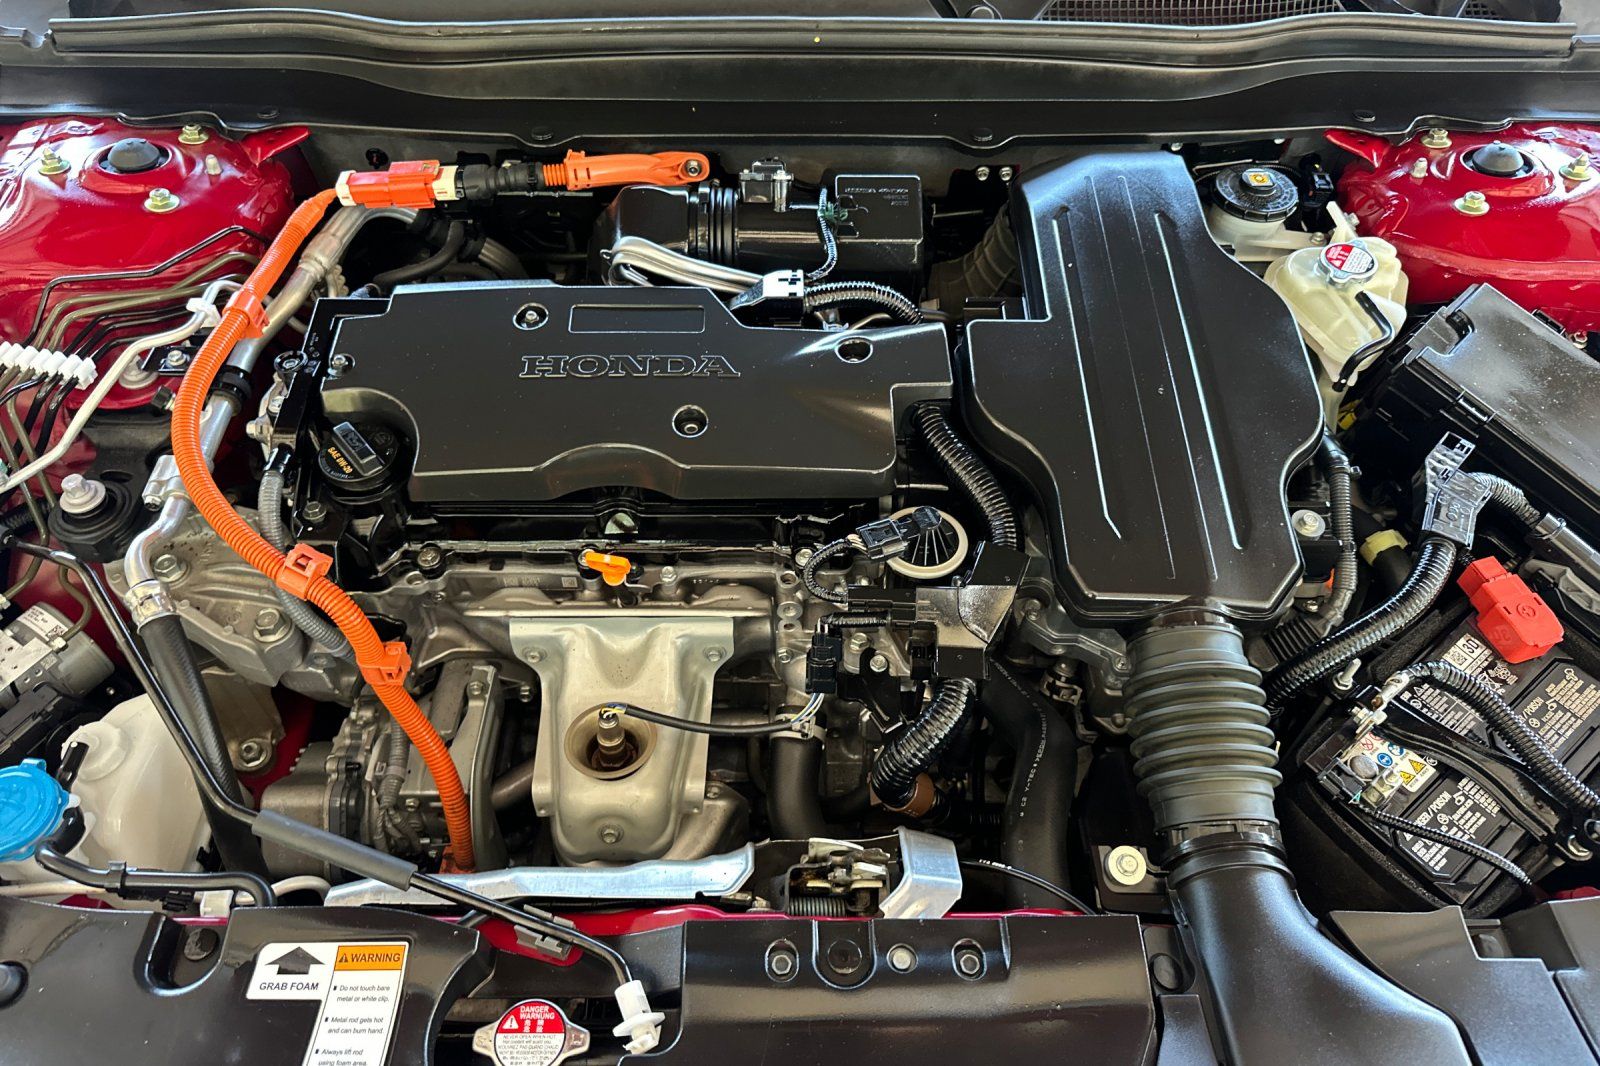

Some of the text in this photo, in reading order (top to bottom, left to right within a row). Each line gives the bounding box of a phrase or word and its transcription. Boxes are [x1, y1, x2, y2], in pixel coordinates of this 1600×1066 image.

[519, 354, 741, 378] HONDA
[328, 446, 342, 460] SAE
[336, 456, 353, 474] 0W-20
[1462, 638, 1479, 654] 3D
[350, 952, 400, 962] WARNING
[290, 982, 319, 990] FOAM
